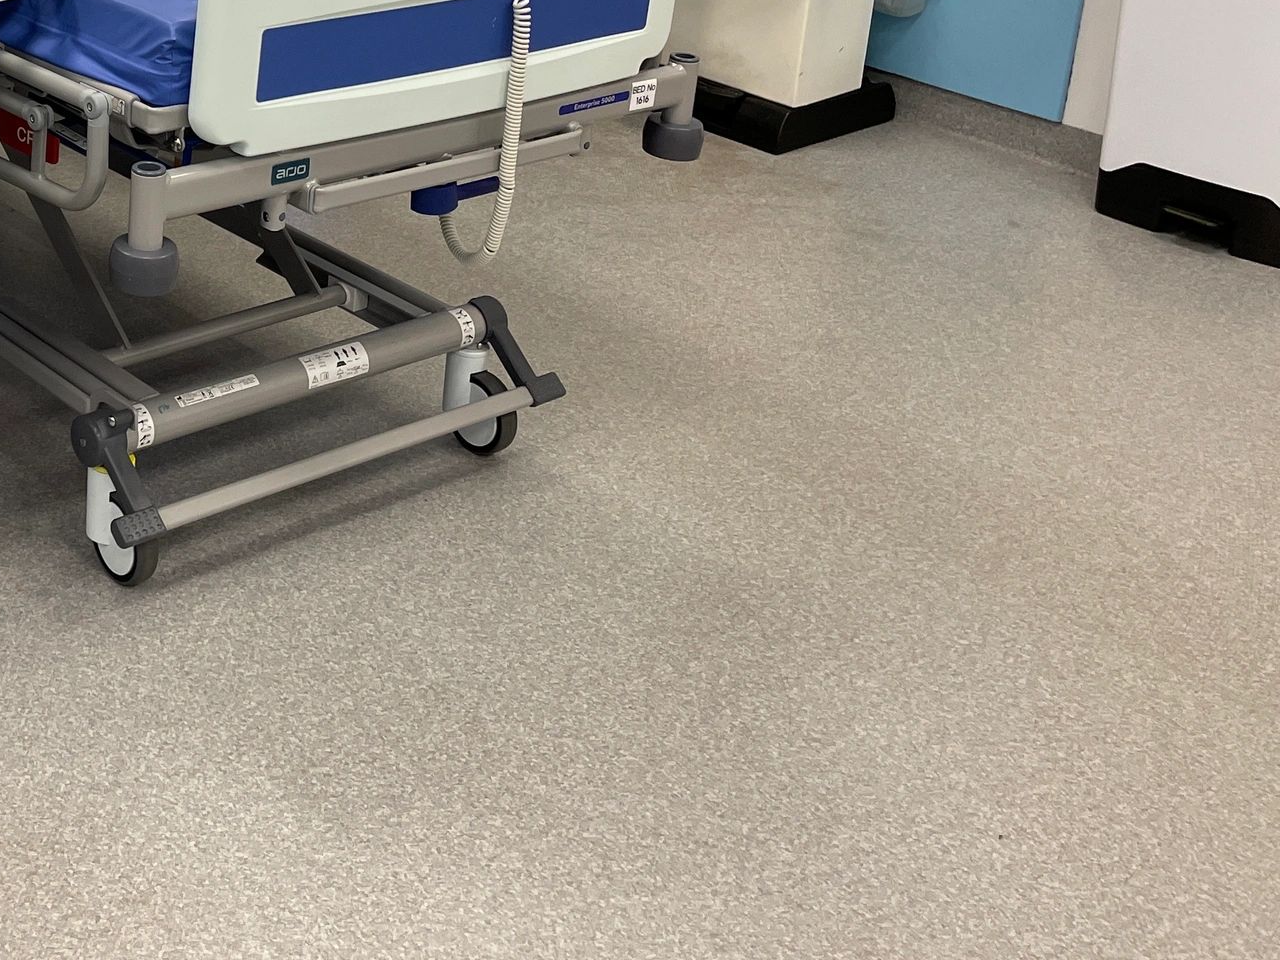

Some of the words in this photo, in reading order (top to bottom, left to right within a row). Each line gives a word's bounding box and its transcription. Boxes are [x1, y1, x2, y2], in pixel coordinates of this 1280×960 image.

[632, 84, 646, 95] BED
[573, 100, 601, 111] Enterprise
[600, 95, 616, 105] 5000
[636, 95, 650, 105] 1616
